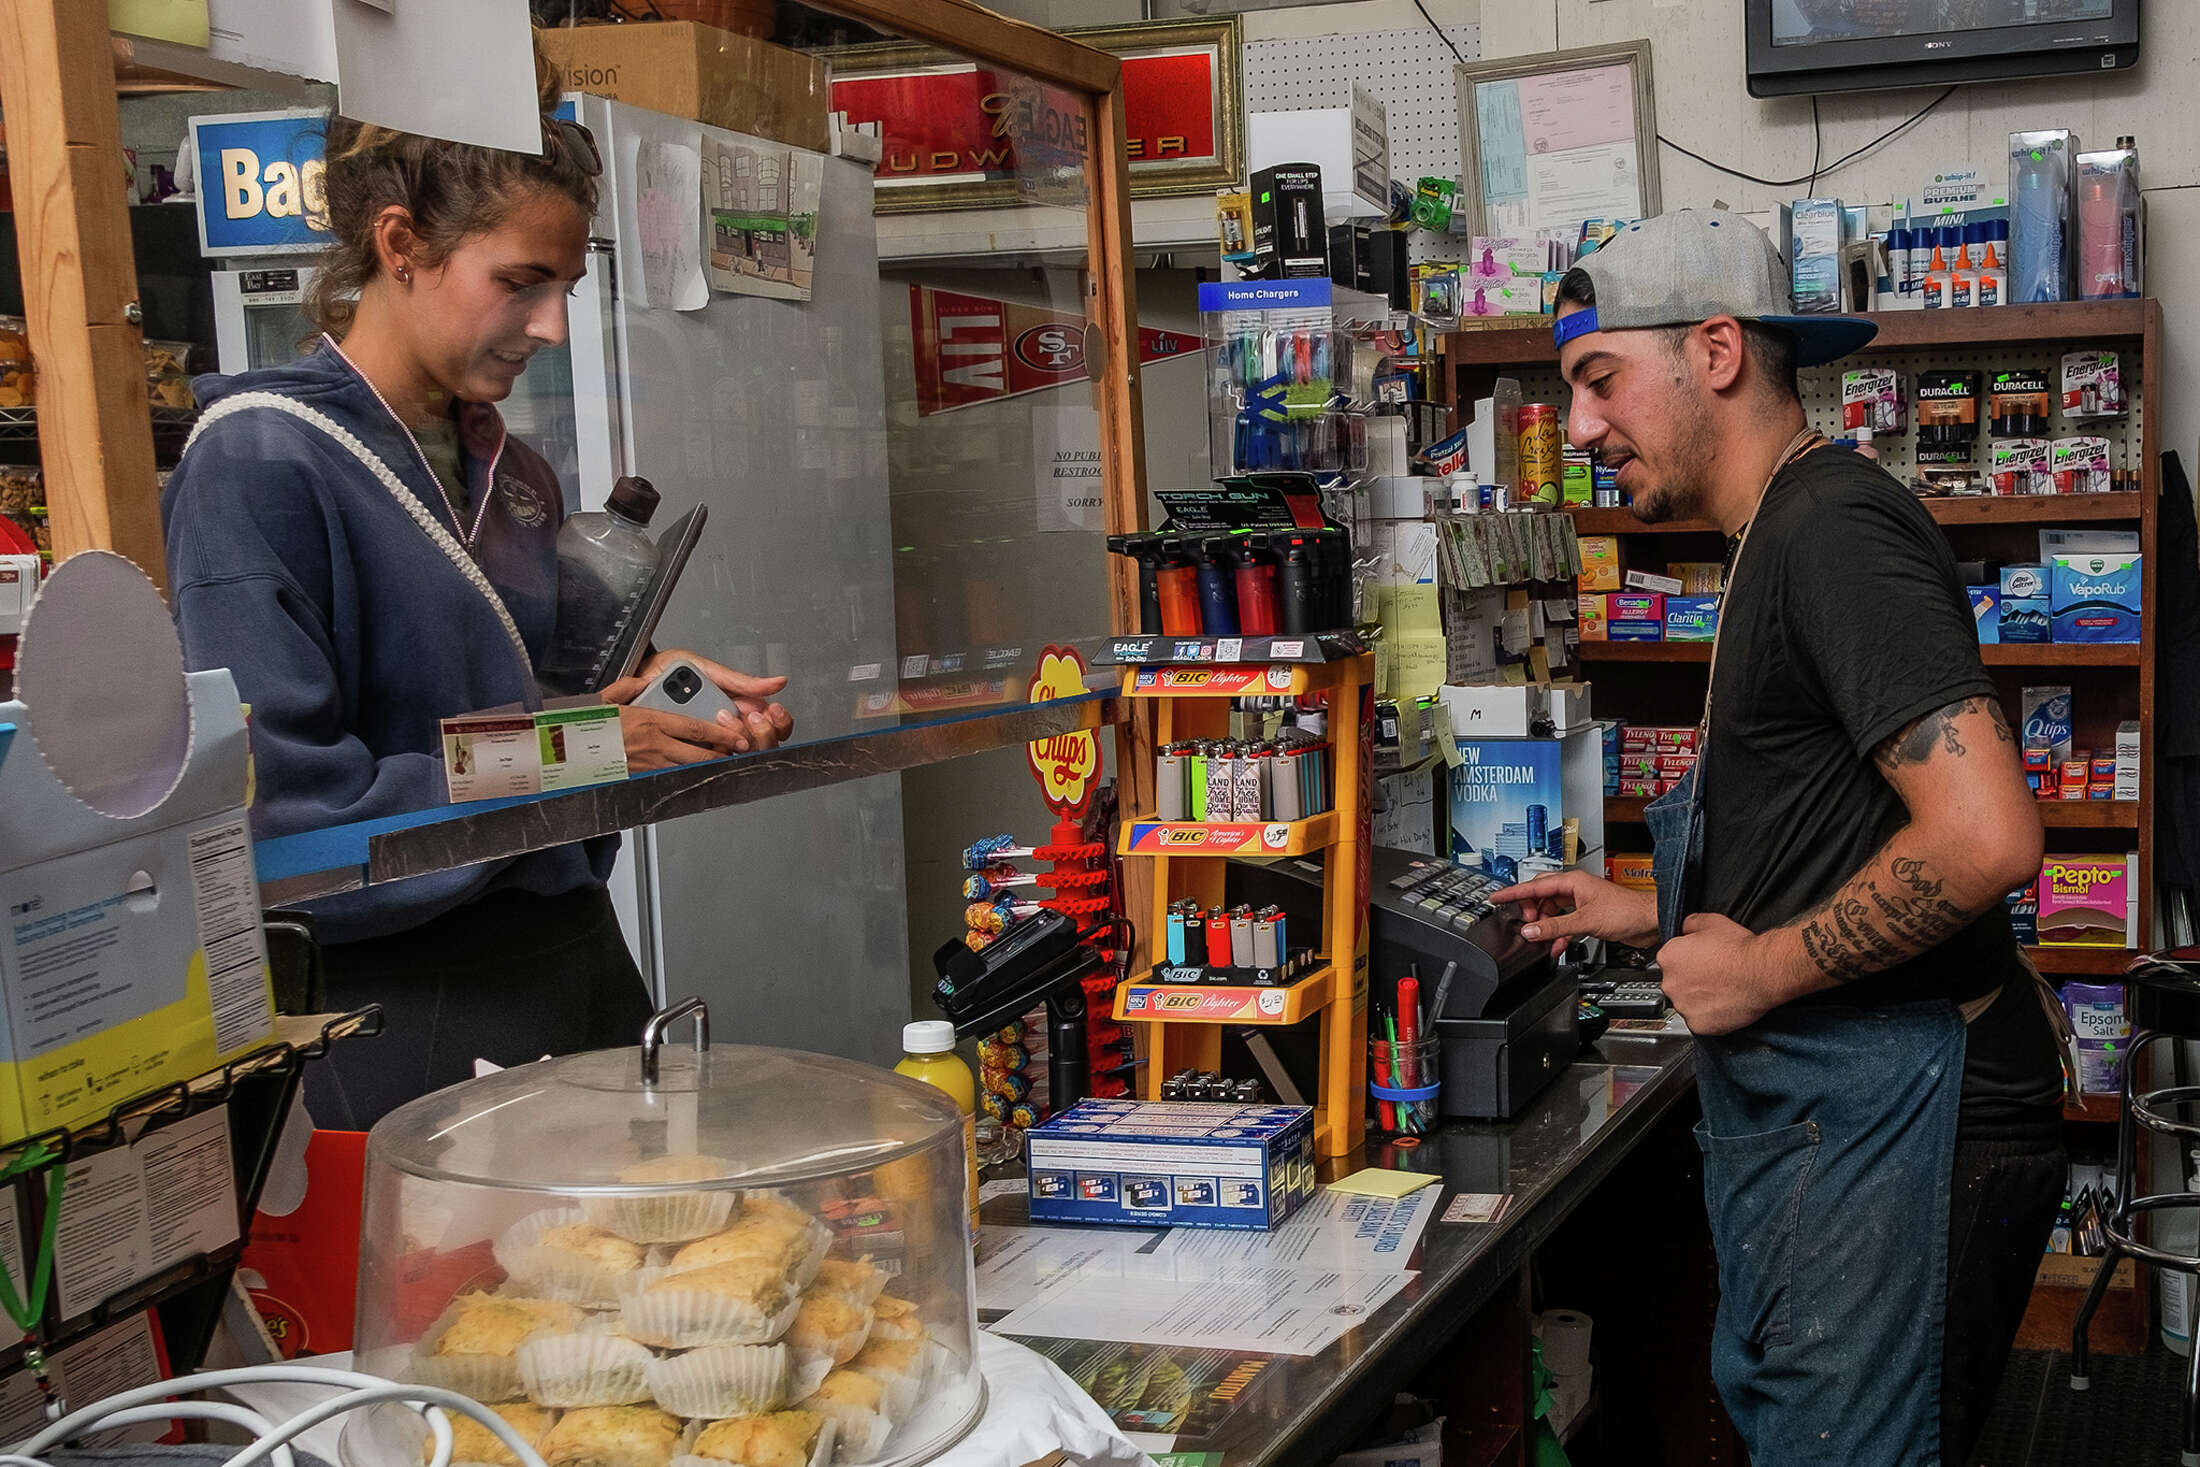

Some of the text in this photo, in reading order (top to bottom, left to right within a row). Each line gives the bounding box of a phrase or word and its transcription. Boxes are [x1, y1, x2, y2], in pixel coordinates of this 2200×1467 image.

[565, 63, 618, 87] ision
[1923, 184, 1977, 198] PREMIUM
[1923, 194, 1977, 205] BUTANE
[1795, 210, 1836, 219] Clearblue
[1933, 213, 1965, 227] MINI
[1228, 289, 1299, 300] Home Chargers
[2065, 358, 2116, 380] Energizer
[1844, 375, 1894, 397] Energizer
[1993, 379, 2045, 391] DURACELL
[1920, 386, 1970, 398] DURACELL
[1055, 451, 1072, 461] NO
[1918, 450, 1968, 462] DURACELL
[1995, 444, 2047, 467] Energizer
[1436, 451, 1467, 477] tella
[1157, 492, 1270, 500] TORCH GUN
[2068, 582, 2127, 598] VapoRub
[1667, 612, 1703, 624] Claritin
[1113, 643, 1149, 652] EAGLE
[1175, 671, 1249, 685] BIC Lighter
[1470, 708, 1482, 721] M
[1455, 766, 1534, 784] AMSTERDAM
[1208, 778, 1230, 786] LAND
[1235, 778, 1258, 787] LAND
[1455, 784, 1498, 802] VODKA
[191, 831, 227, 848] Supplement
[1171, 831, 1205, 842] BIC
[2052, 864, 2112, 887] Pepto
[2052, 883, 2089, 894] Bismol
[1171, 968, 1197, 979] BIC
[1165, 994, 1240, 1011] BIC Lighter
[2081, 1012, 2125, 1027] Epsom
[2093, 1026, 2114, 1036] Salt
